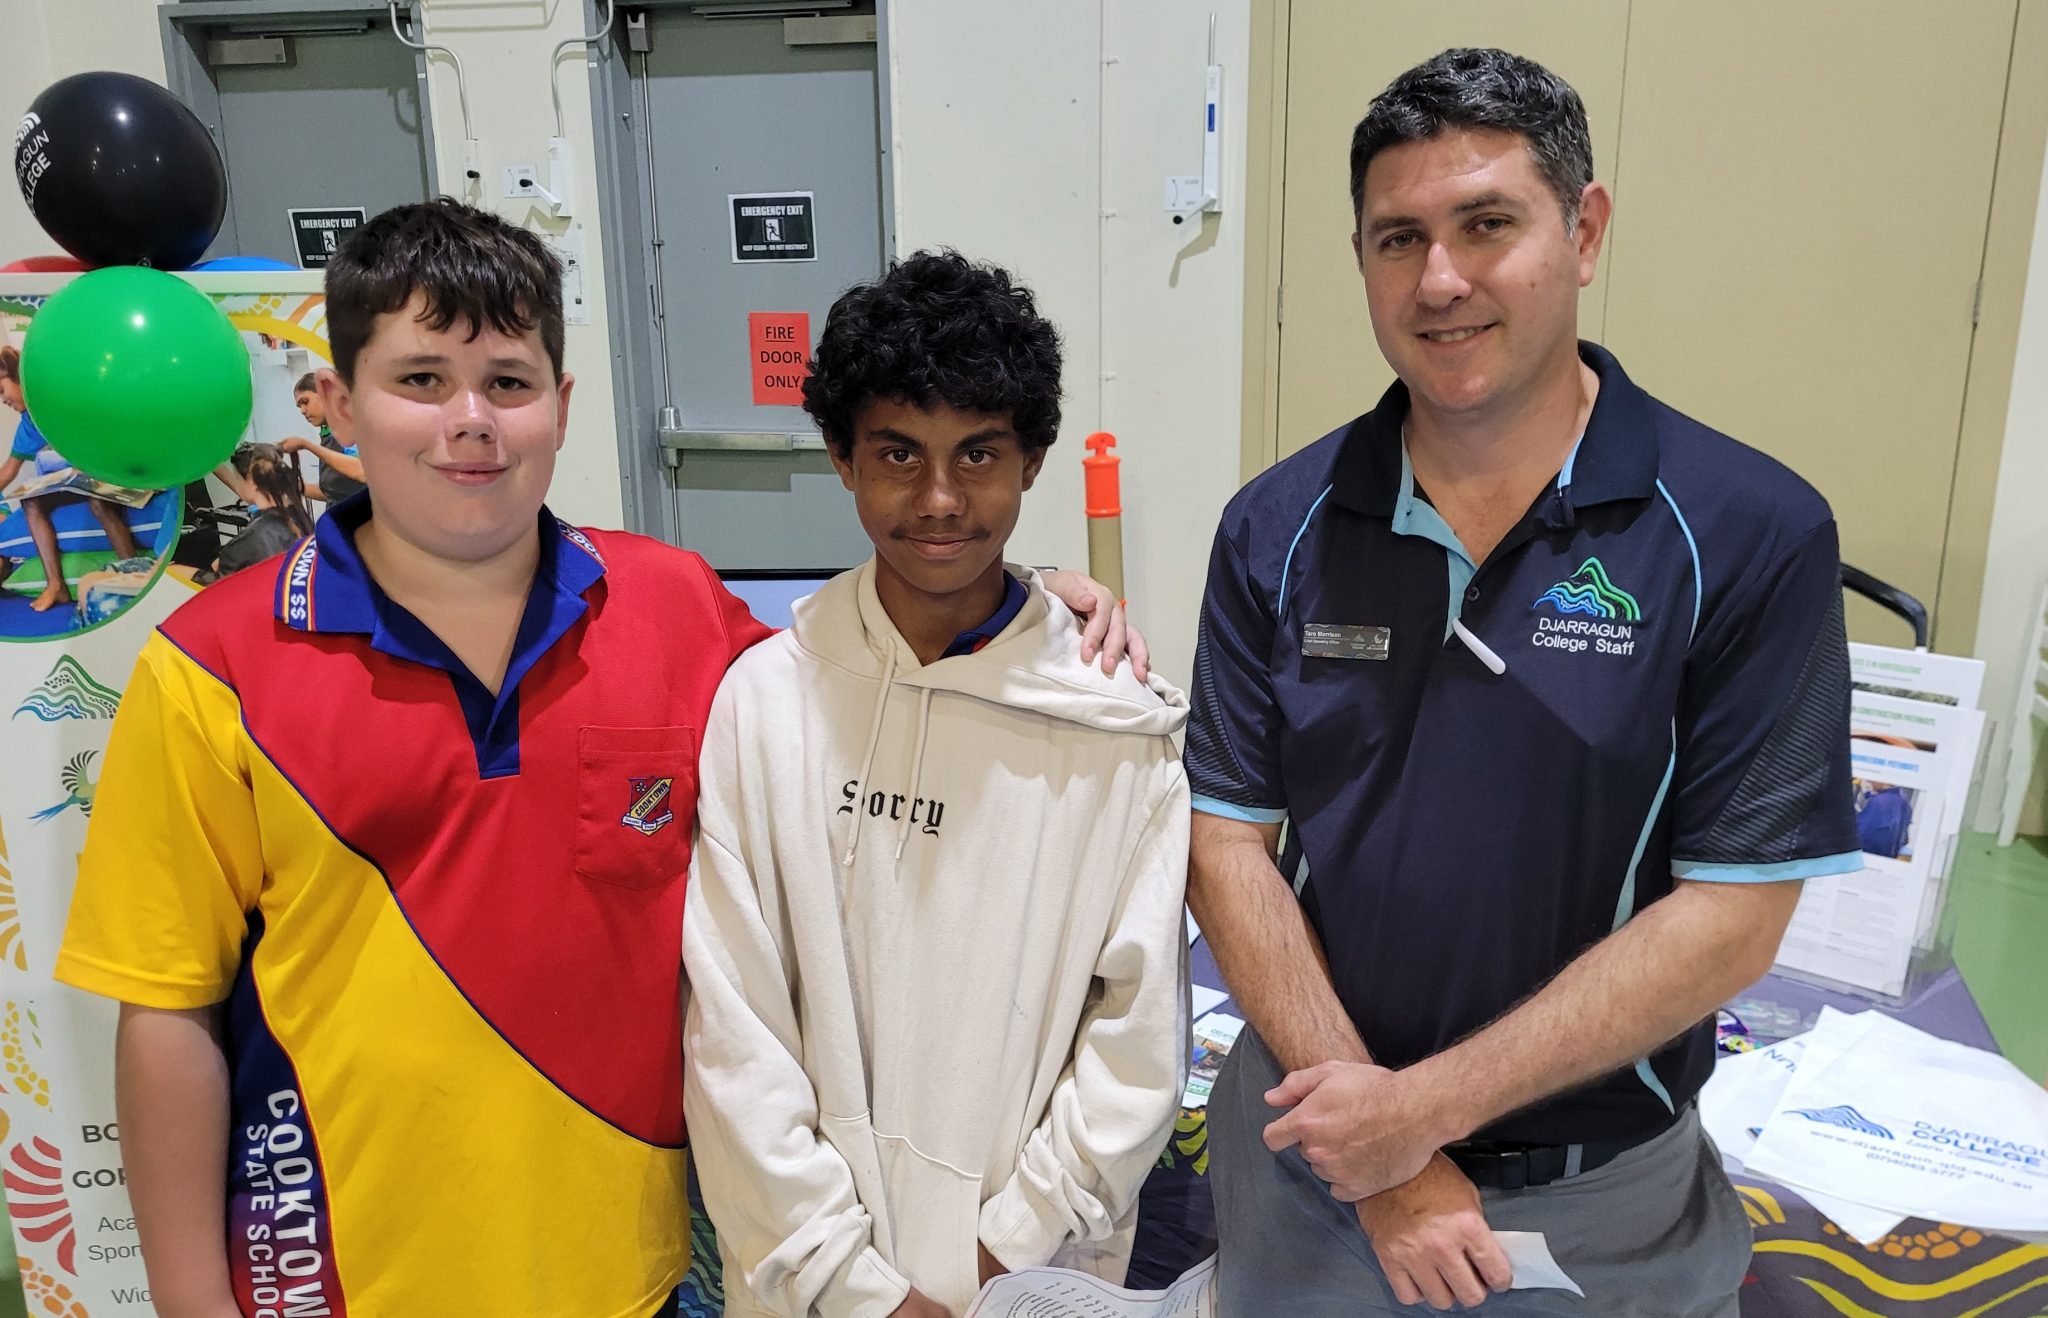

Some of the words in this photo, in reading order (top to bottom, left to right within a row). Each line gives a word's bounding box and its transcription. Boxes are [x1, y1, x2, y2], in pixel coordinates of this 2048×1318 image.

[741, 206, 786, 216] EMERGENCY
[786, 205, 804, 215] EXIT
[300, 219, 340, 229] EMERGENCY
[340, 218, 357, 228] EXIT
[765, 326, 795, 340] FIRE
[760, 350, 803, 364] DOOR
[764, 375, 801, 388] ONLY
[290, 593, 306, 621] SS
[1539, 617, 1632, 640] DJARRAGUN
[1531, 632, 1588, 653] College
[1595, 638, 1635, 656] Staff
[635, 781, 669, 817] COOKTOWN
[837, 779, 944, 839] Sorry
[1912, 1130, 2041, 1168] COLLEGE
[245, 1123, 275, 1211] STATE
[267, 1089, 331, 1318] COOKTOW
